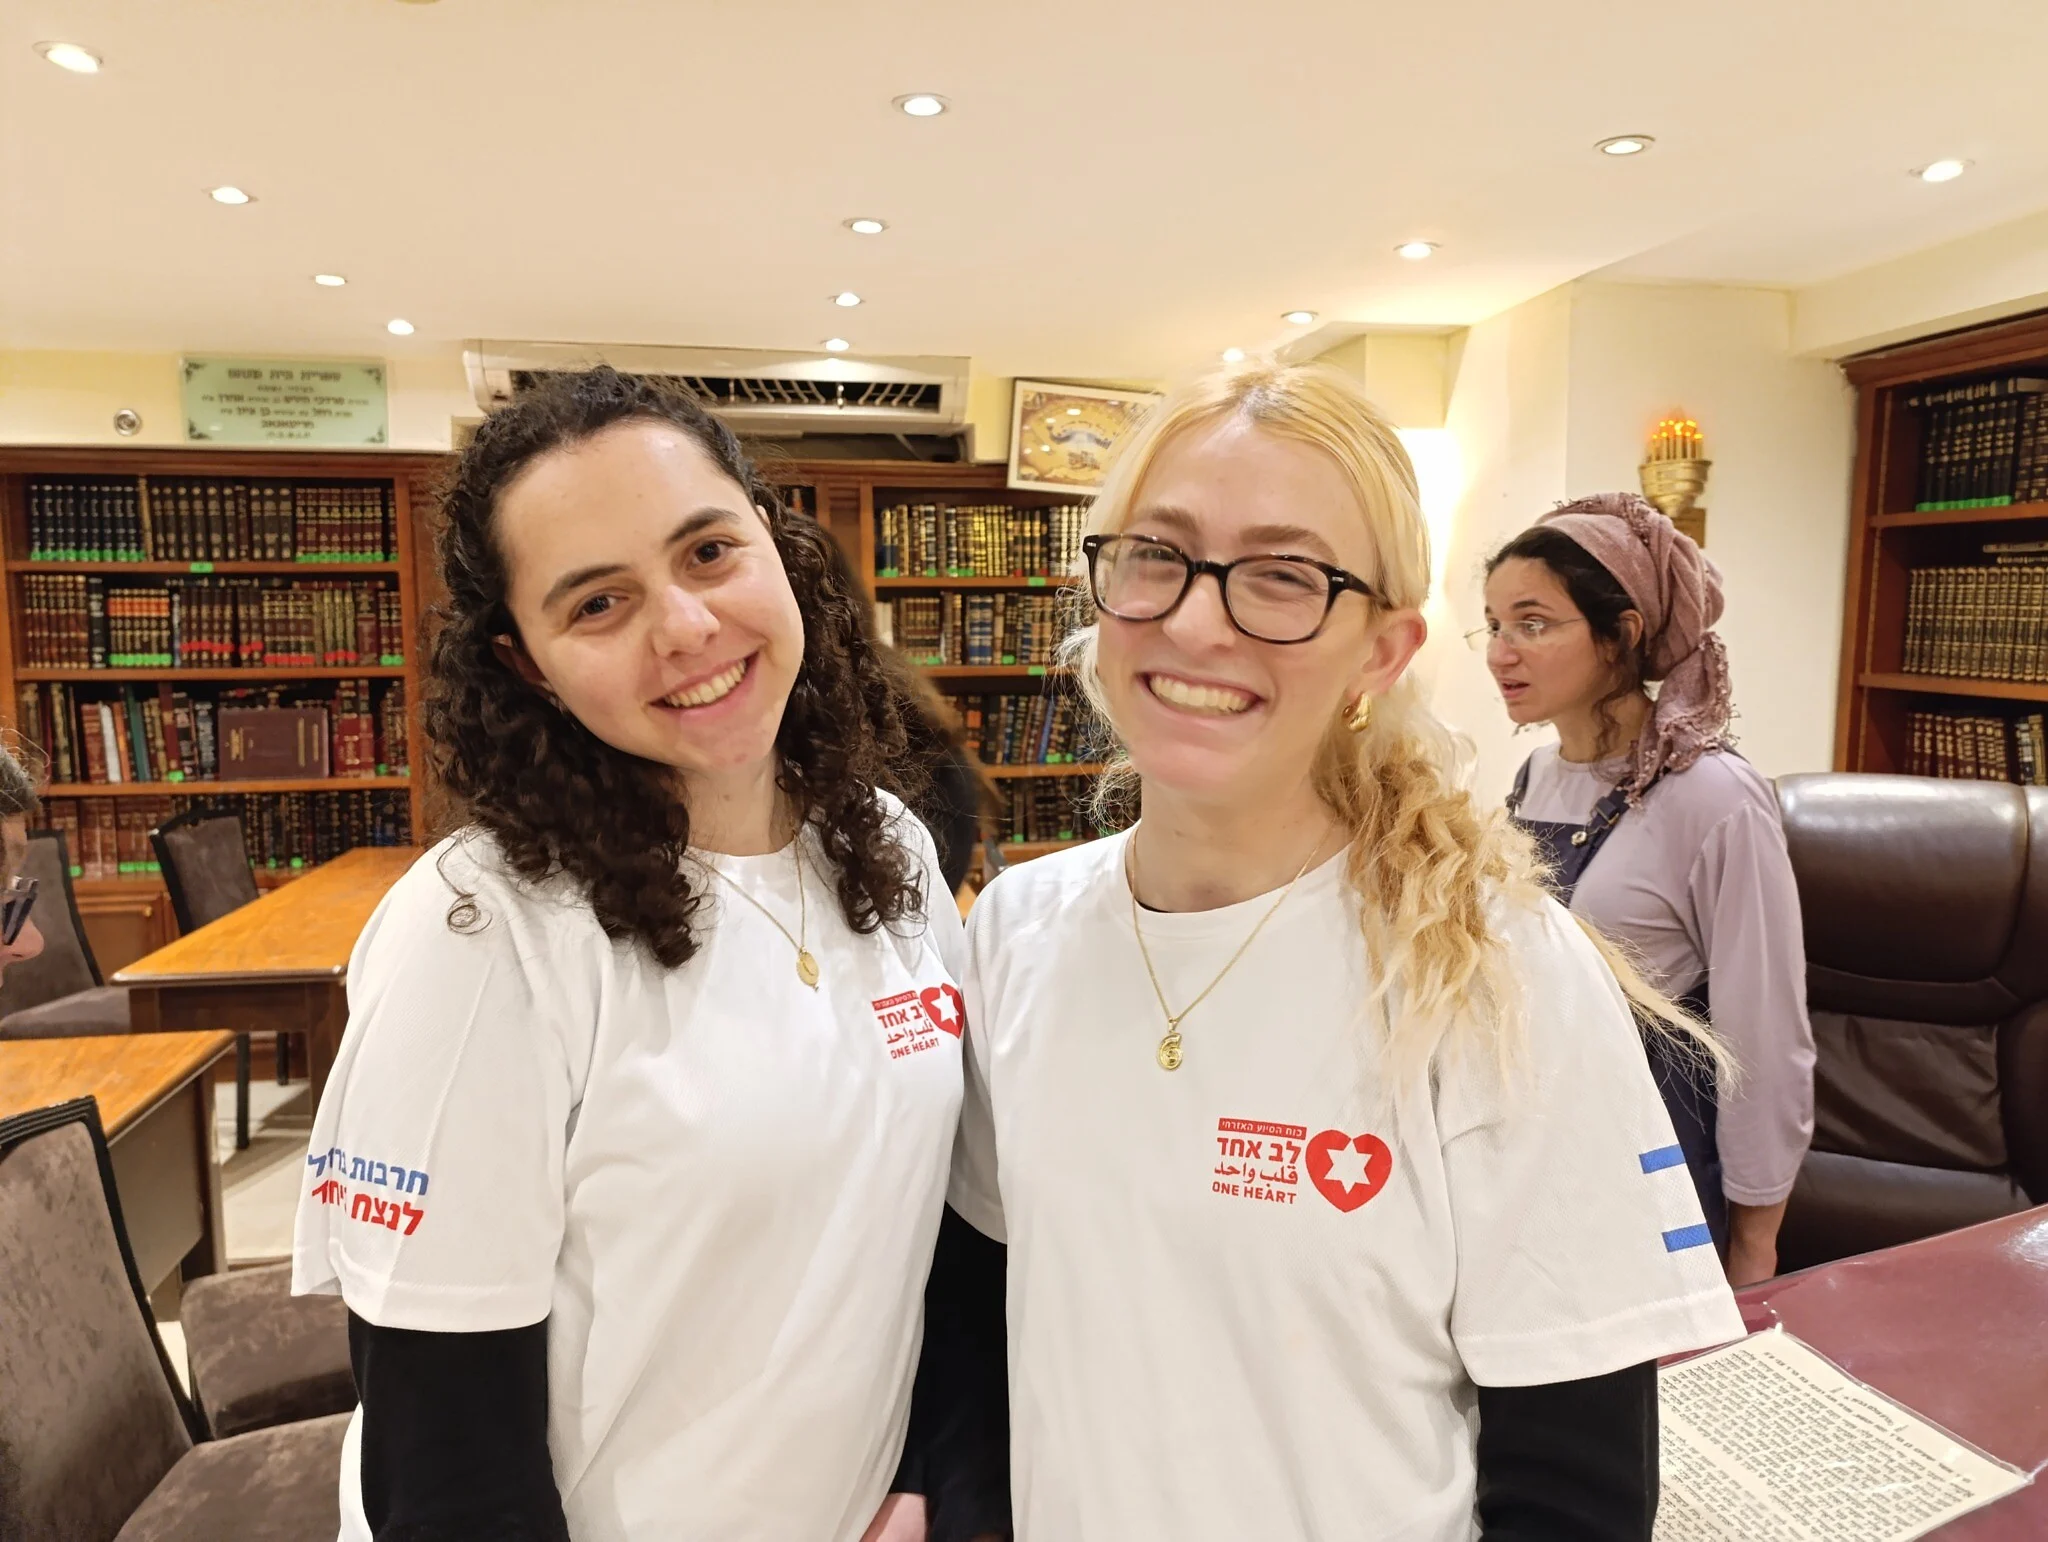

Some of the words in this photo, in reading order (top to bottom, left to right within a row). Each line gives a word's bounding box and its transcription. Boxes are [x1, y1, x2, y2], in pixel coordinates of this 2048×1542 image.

[877, 1008, 910, 1029] אחד
[886, 1027, 915, 1044] واحد
[890, 1045, 911, 1060] ONE
[911, 1037, 940, 1053] HEART
[1221, 1120, 1253, 1131] האזרחי
[1256, 1124, 1282, 1134] הסיוע
[1286, 1128, 1303, 1137] כוח
[1216, 1137, 1263, 1159] אחד
[1268, 1140, 1302, 1164] לב
[349, 1156, 429, 1196] חרבות
[1214, 1161, 1256, 1183] واحد
[1259, 1165, 1299, 1187] قلب
[1212, 1181, 1239, 1196] ONE
[1243, 1185, 1297, 1205] HEART
[351, 1193, 424, 1236] לנצח
